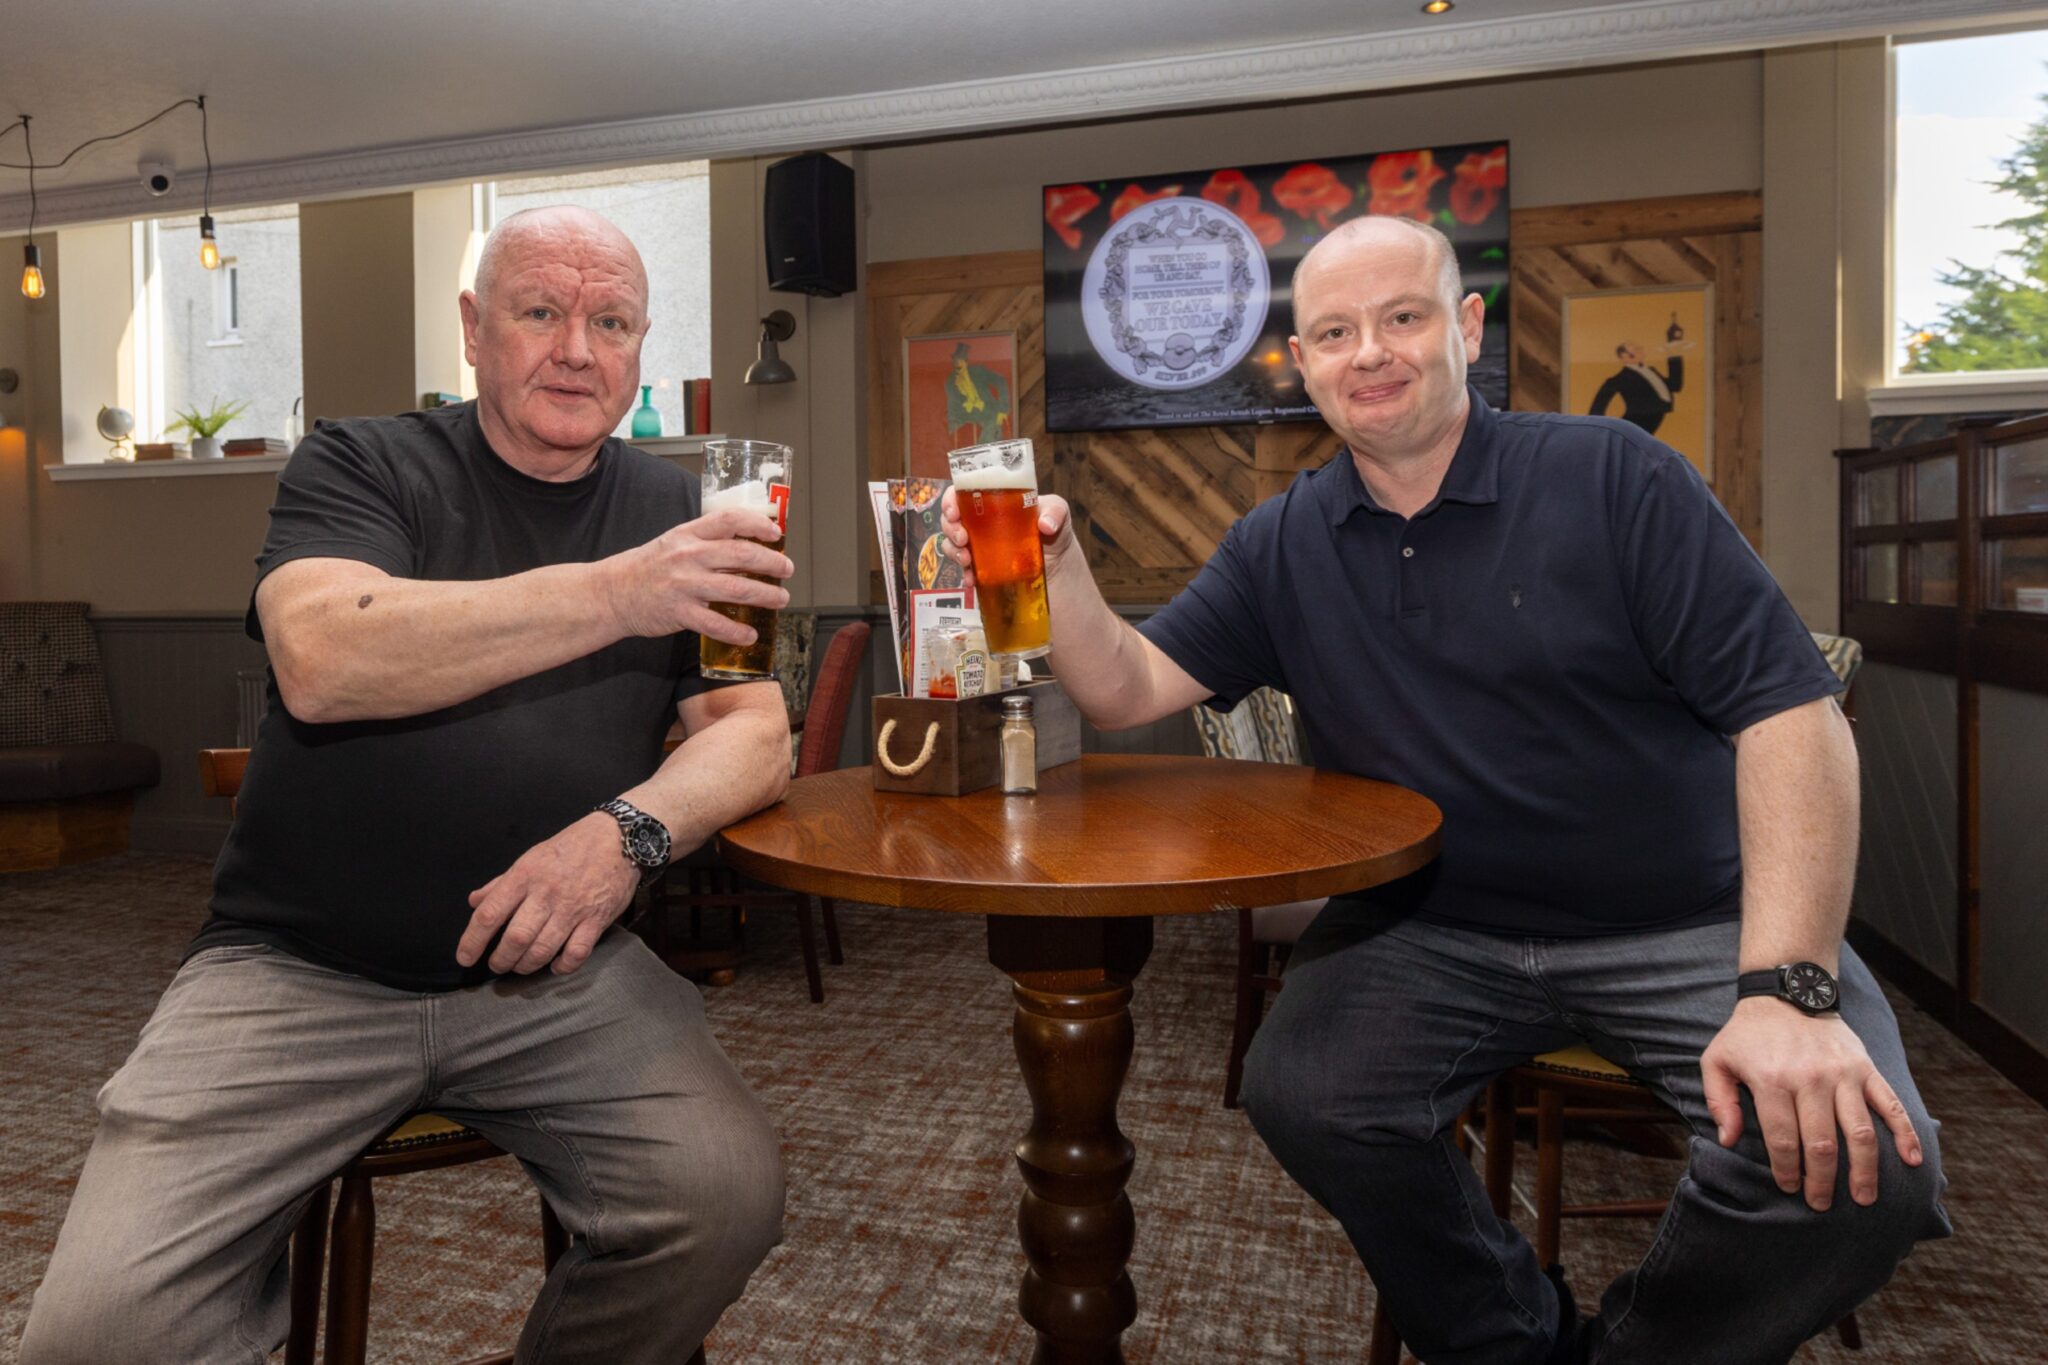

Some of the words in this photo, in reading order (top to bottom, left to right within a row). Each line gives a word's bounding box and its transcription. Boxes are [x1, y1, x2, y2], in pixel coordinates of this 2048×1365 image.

[1148, 254, 1175, 263] WHEN
[1176, 252, 1194, 262] YOU
[1132, 291, 1149, 301] FOR
[1150, 289, 1174, 300] YOUR
[1143, 301, 1170, 316] WE
[1171, 298, 1213, 314] GAVE
[1135, 317, 1169, 333] OUR
[1169, 312, 1223, 330] TODAY
[963, 670, 983, 680] TOMATO
